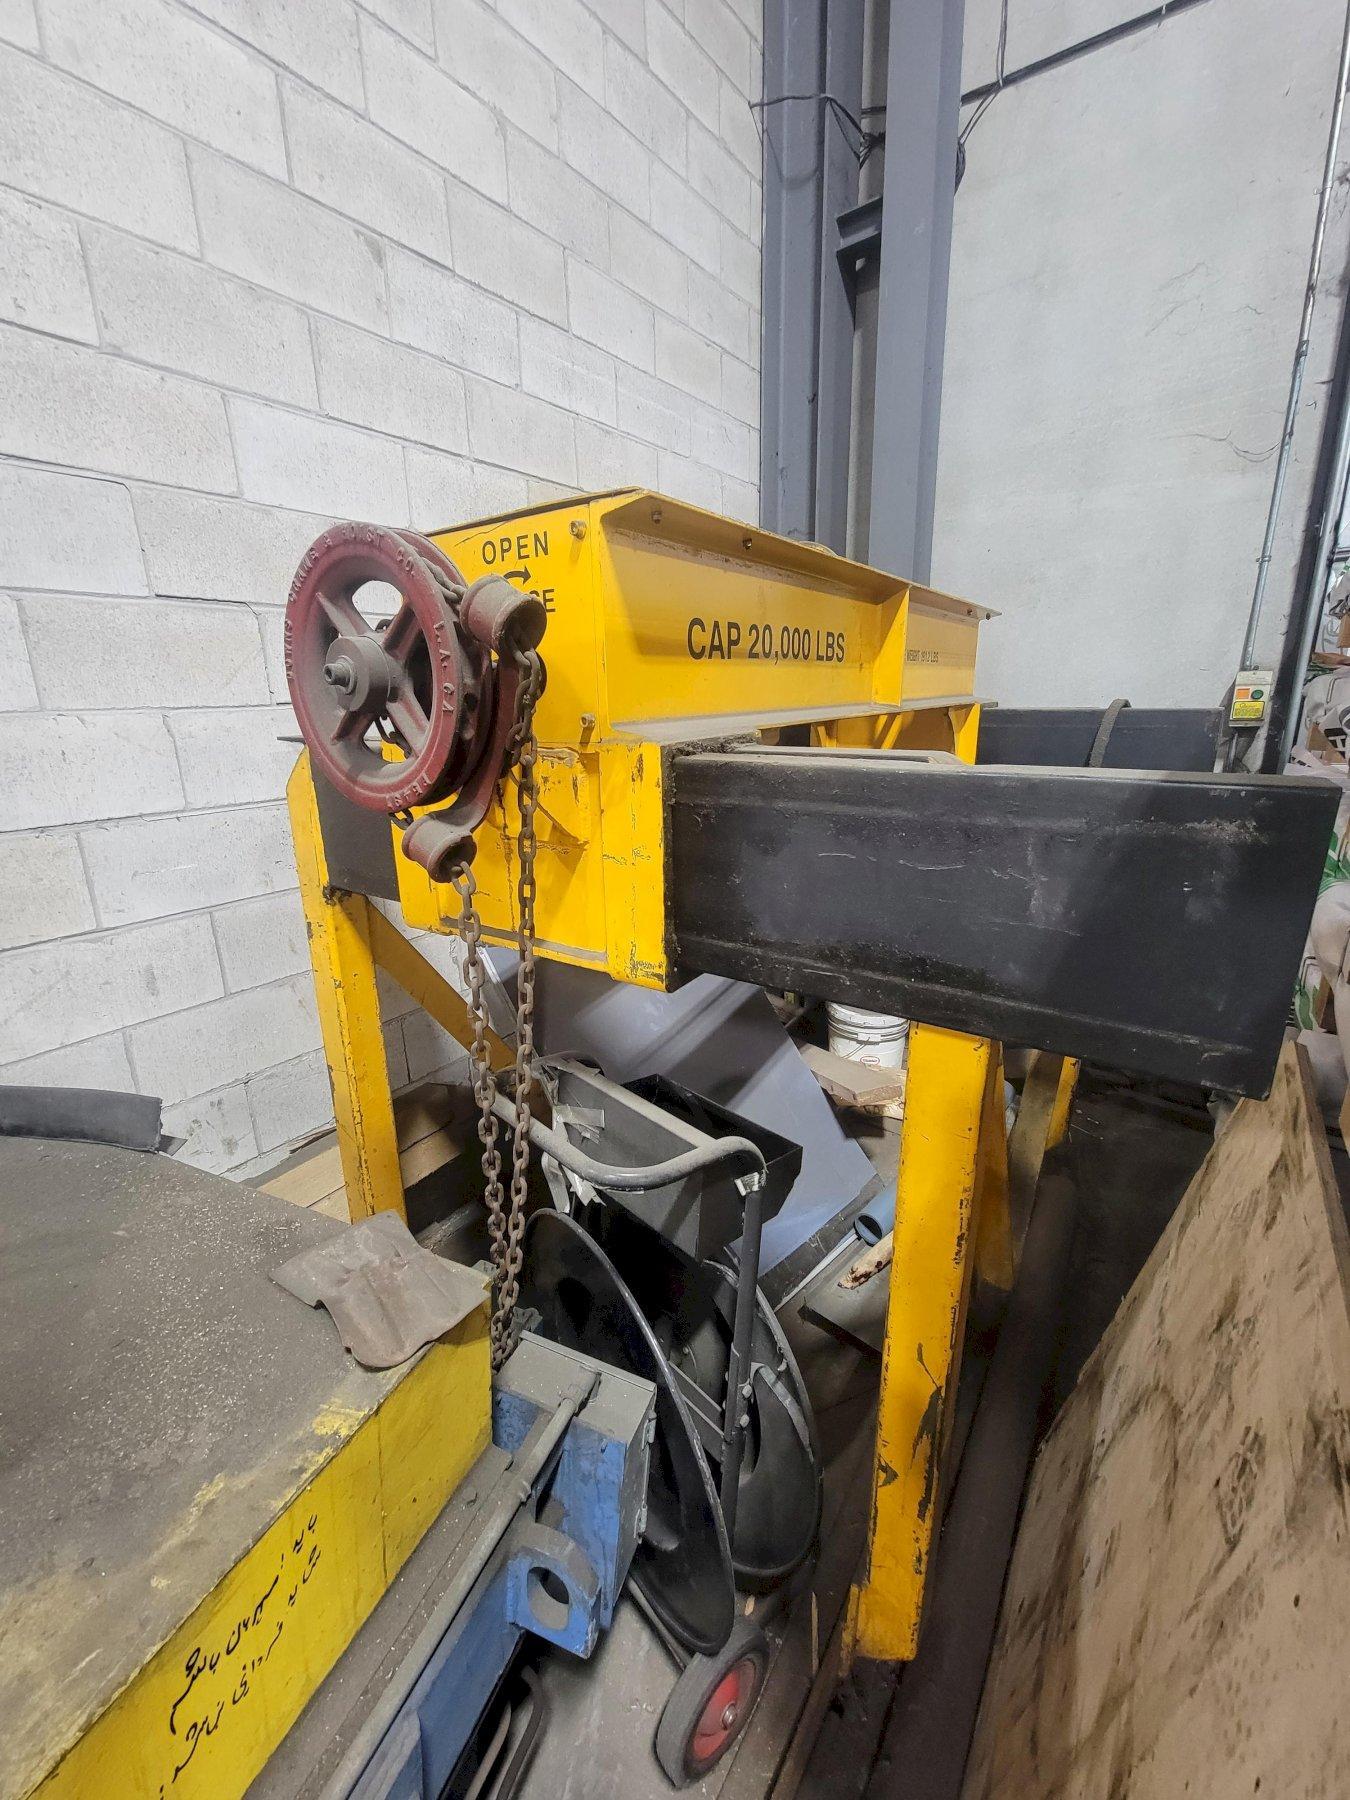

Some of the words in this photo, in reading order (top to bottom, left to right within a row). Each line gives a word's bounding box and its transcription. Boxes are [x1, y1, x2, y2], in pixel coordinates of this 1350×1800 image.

[482, 531, 549, 565] OPEN
[687, 617, 741, 661] CAP
[747, 623, 811, 666] 20,000
[816, 629, 845, 664] LBS
